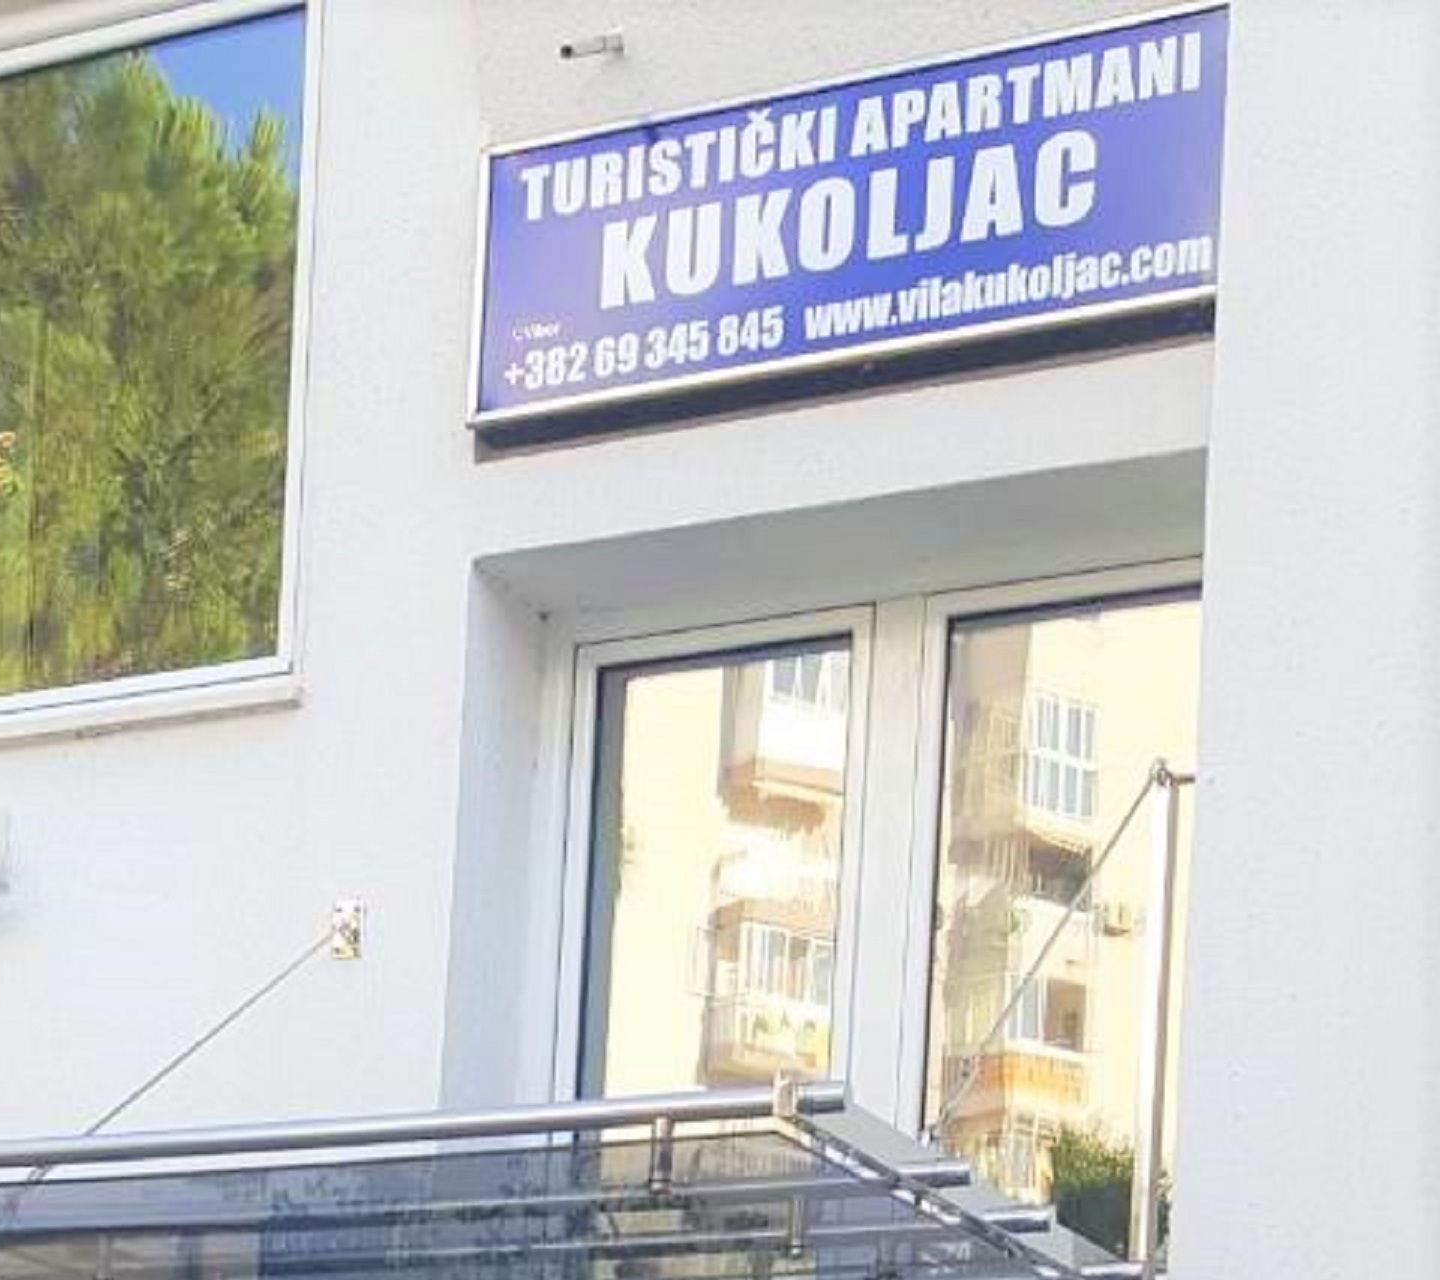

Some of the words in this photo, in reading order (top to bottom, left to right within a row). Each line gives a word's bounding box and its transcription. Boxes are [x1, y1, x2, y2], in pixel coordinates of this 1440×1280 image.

[522, 107, 837, 221] TURISTIČKI
[849, 31, 1201, 158] APARTMANI
[600, 129, 1096, 309] KUKOLJAC
[504, 341, 588, 390] +382
[593, 332, 640, 378] 69
[644, 319, 709, 369] 345
[717, 305, 785, 356] 845
[804, 235, 1213, 341] www.vilakukoljac.com
